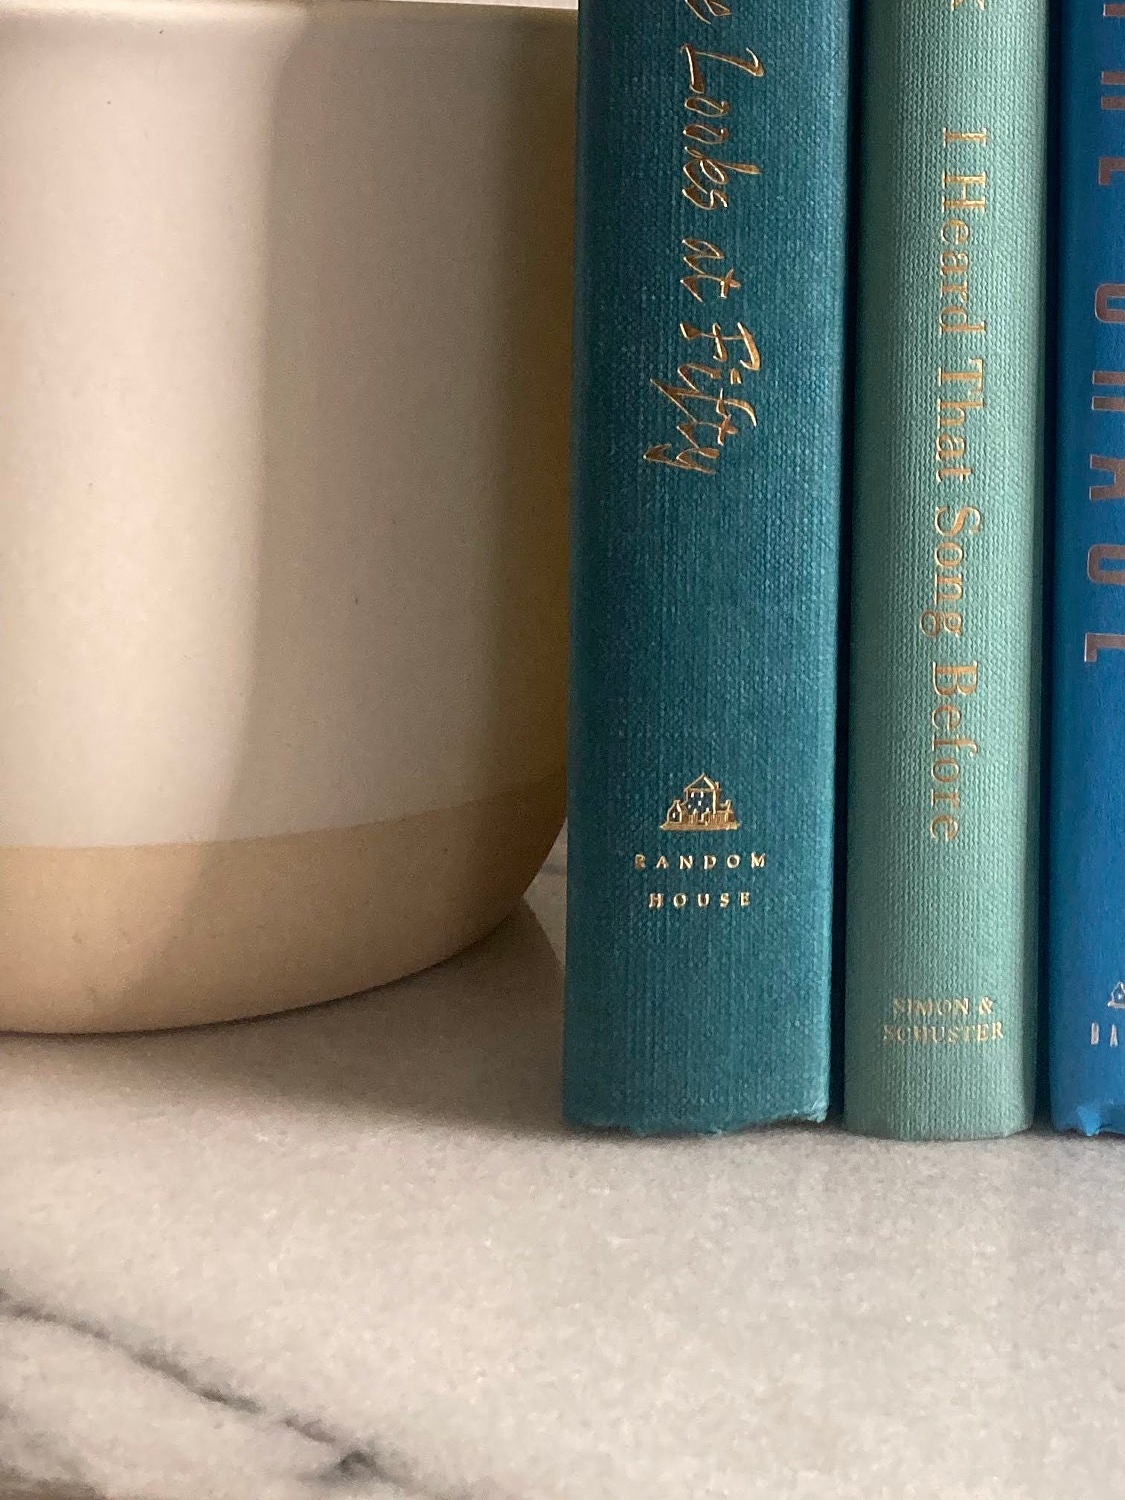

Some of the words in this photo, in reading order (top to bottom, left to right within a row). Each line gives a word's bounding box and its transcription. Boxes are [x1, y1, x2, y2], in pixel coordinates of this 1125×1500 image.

[679, 43, 766, 211] Looks
[942, 127, 987, 147] I
[680, 237, 742, 303] at
[938, 171, 987, 336] Heard
[643, 321, 761, 476] Fifty
[935, 358, 985, 484] That
[920, 505, 981, 638] Song
[930, 660, 978, 842] Before
[634, 852, 767, 871] RANDOM
[648, 886, 752, 910] HOUSE
[892, 997, 970, 1017] SIMON
[977, 996, 994, 1016] &
